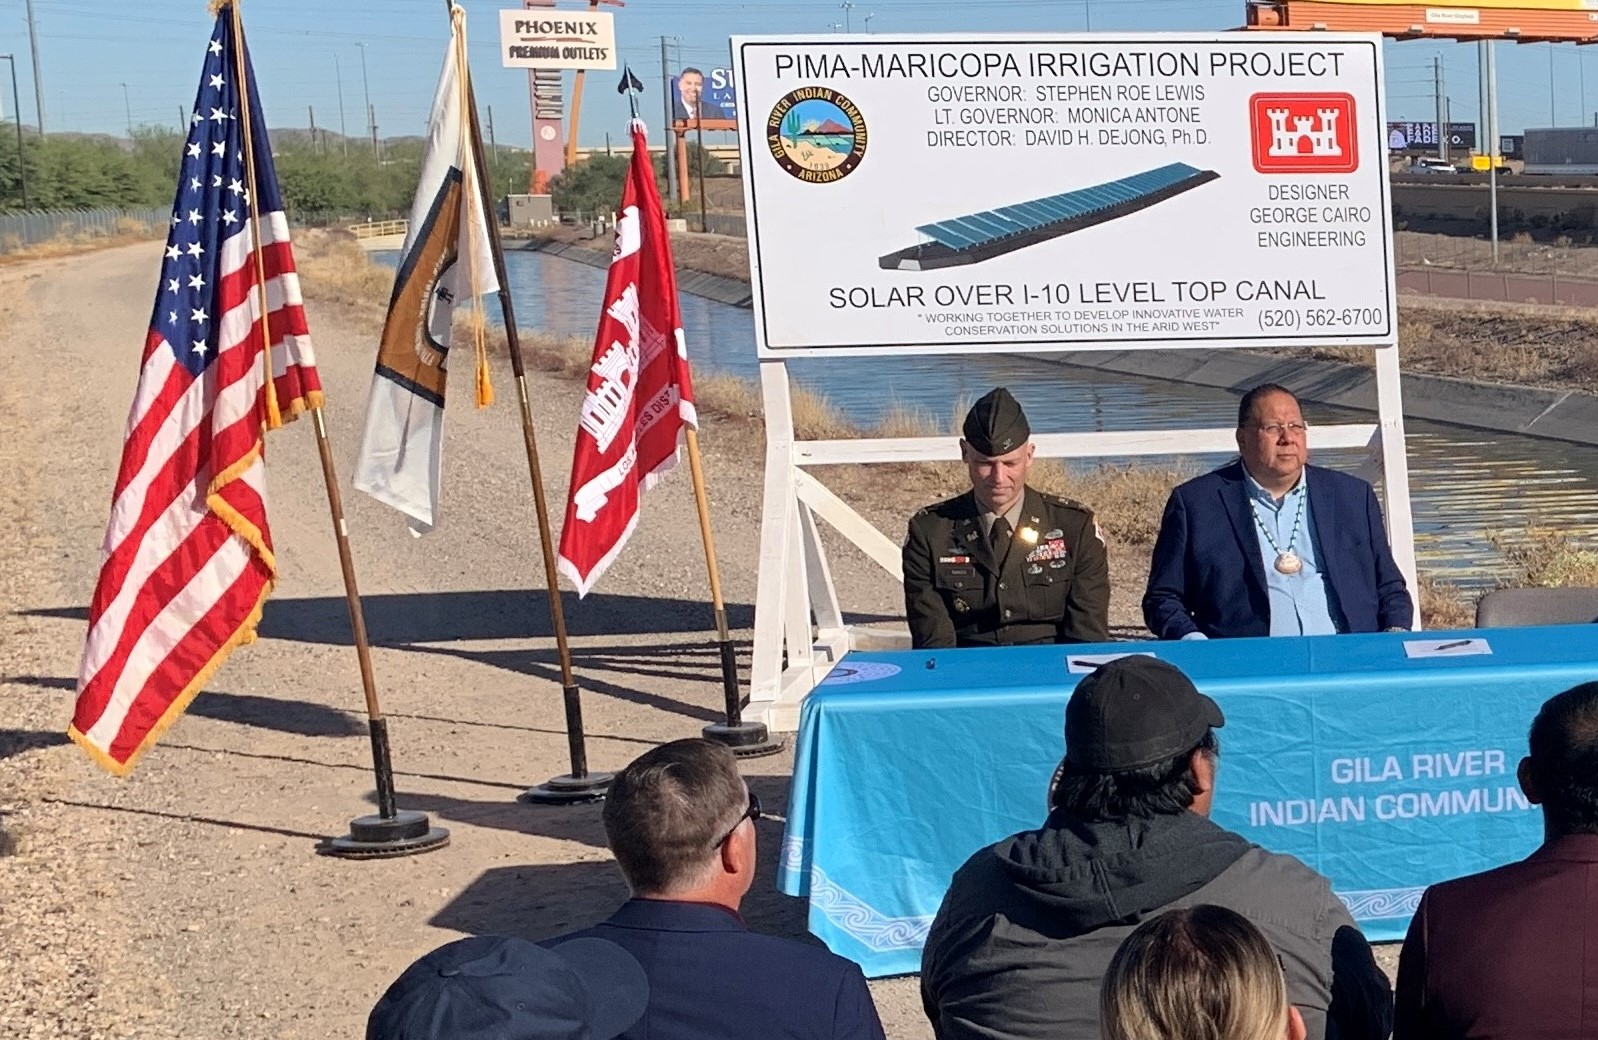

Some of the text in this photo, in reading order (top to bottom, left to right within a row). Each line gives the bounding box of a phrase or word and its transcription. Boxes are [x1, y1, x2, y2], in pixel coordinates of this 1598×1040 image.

[515, 20, 598, 35] PHOENIX
[562, 46, 609, 61] OUTLETS
[775, 52, 1345, 78] PIMA-MARICOPA IRRIGATION PROJECT
[792, 87, 832, 102] INDIAN
[928, 84, 1205, 102] GOVERNOR: STEPHEN ROE LEWIS
[769, 98, 792, 127] RIVER
[935, 107, 1201, 124] LT. GOVERNOR: MONICA ANTONE
[835, 95, 866, 158] COMMUNITY
[928, 128, 1211, 147] DIRECTOR: DAVID H. DEJONG, Ph.D.
[769, 134, 785, 159] GILA
[798, 168, 843, 182] ARIZONA
[1269, 184, 1350, 200] DESIGNER
[1250, 206, 1371, 223] GEORGE CAIRO
[1258, 230, 1366, 247] ENGINEERING
[829, 280, 1326, 309] SOLAR OVER I-10 LEVEL TOP CANAL
[925, 313, 984, 323] WORKING
[989, 311, 1052, 322] TOGETHER
[1055, 311, 1071, 321] TO
[1074, 310, 1130, 321] DEVELOP
[1132, 308, 1201, 319] INNOVATIVE
[1203, 308, 1244, 318] WATER
[1258, 308, 1382, 332] (520) 562-6700
[945, 324, 1038, 336] CONSERVATION
[1041, 323, 1109, 334] SOLUTIONS
[1112, 323, 1123, 333] IN
[1126, 322, 1150, 332] THE
[1152, 322, 1180, 332] ARID
[1331, 750, 1505, 784] GILA RIVER
[1250, 786, 1540, 827] INDIAN COMMUN
